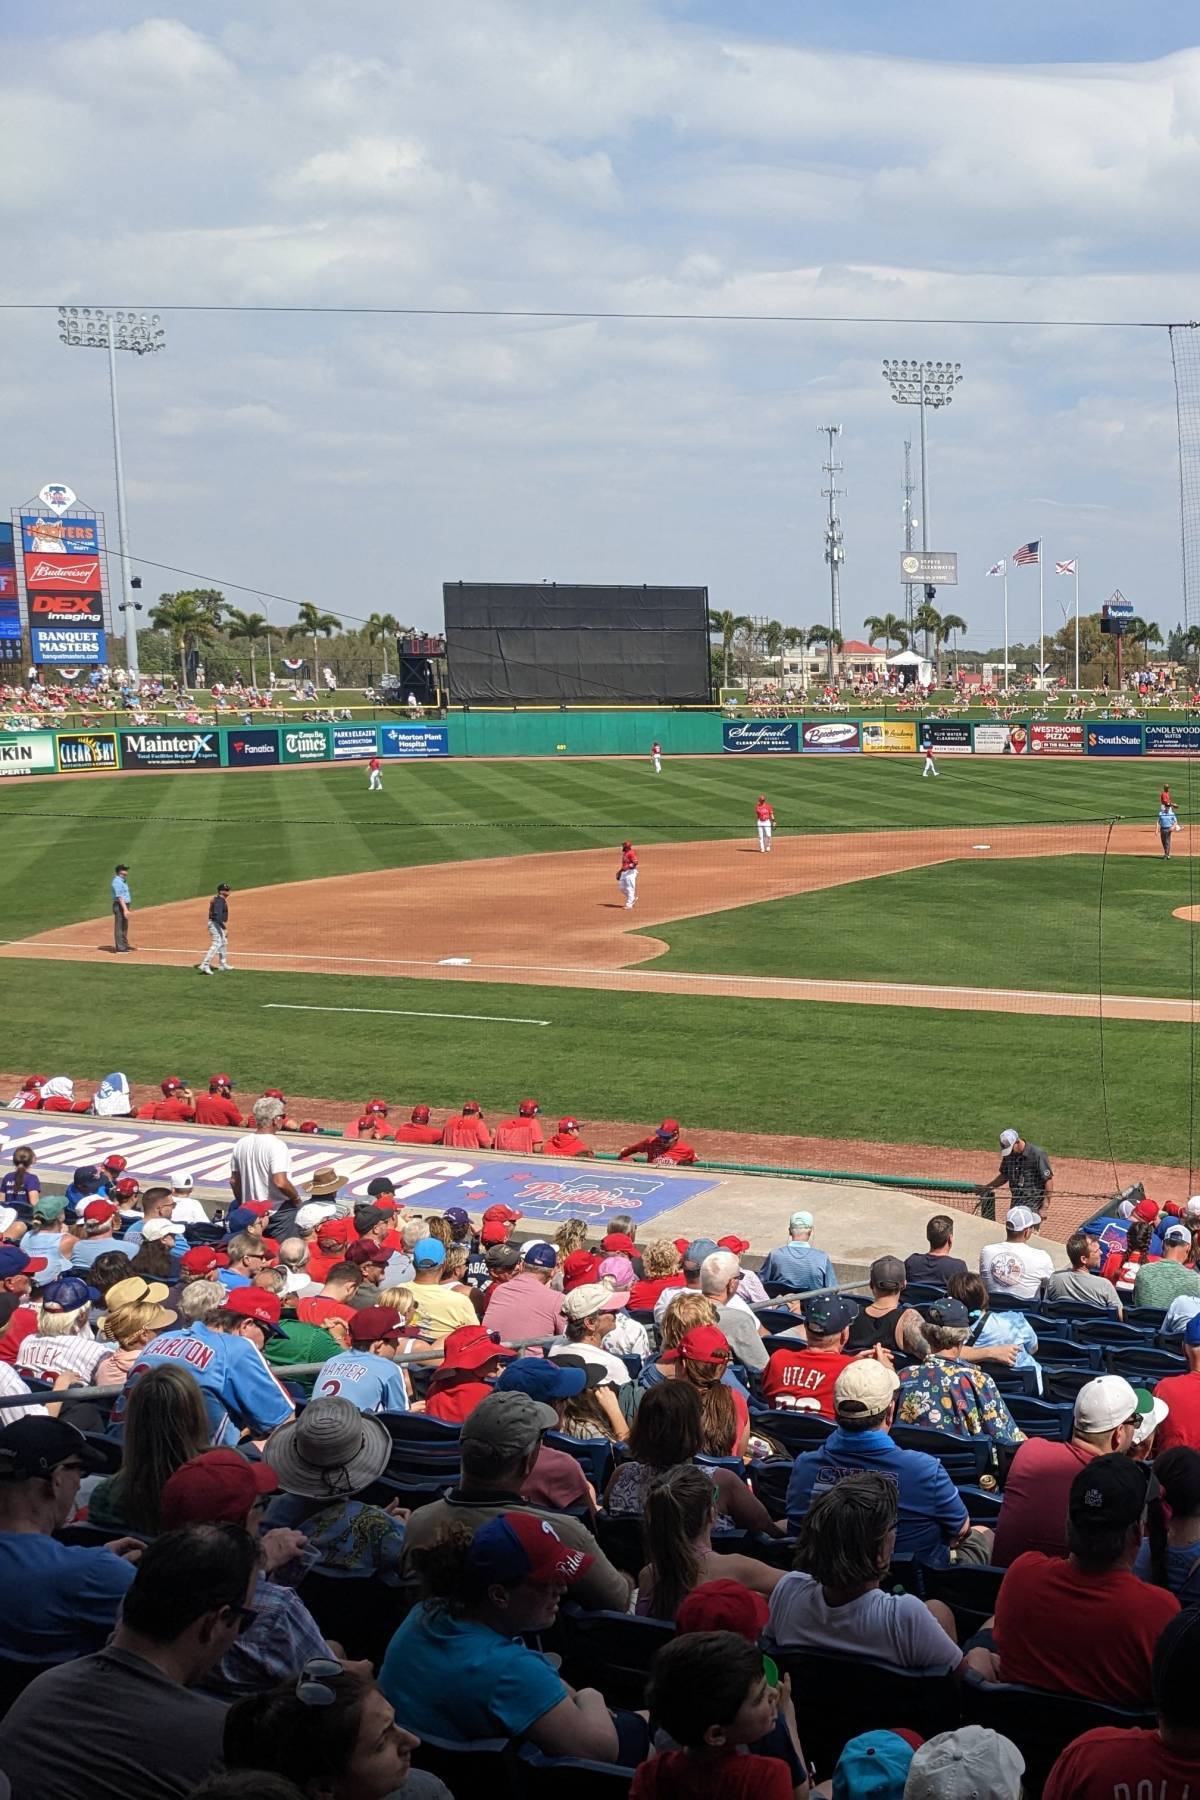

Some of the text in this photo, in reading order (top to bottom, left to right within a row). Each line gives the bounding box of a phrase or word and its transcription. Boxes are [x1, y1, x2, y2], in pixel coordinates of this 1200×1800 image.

[36, 566, 91, 577] Budweiser
[32, 595, 95, 612] DEX
[48, 612, 101, 622] imaging
[38, 632, 99, 642] BANQUET
[39, 643, 100, 652] MASTERS
[286, 734, 327, 753] Times
[424, 733, 442, 741] Plant
[1098, 735, 1141, 745] SouthState
[60, 742, 115, 762] CLEAR SKY
[126, 734, 214, 756] MaintenX
[244, 744, 275, 754] Fanatics
[399, 741, 427, 749] Hospital
[0, 746, 33, 761] KIN
[514, 1182, 642, 1209] Phillies
[468, 1262, 490, 1276] ABRE
[22, 1345, 62, 1367] UTLEY
[144, 1337, 215, 1372] CARLTON
[321, 1363, 368, 1384] HARPER
[783, 1366, 826, 1391] UTLEY
